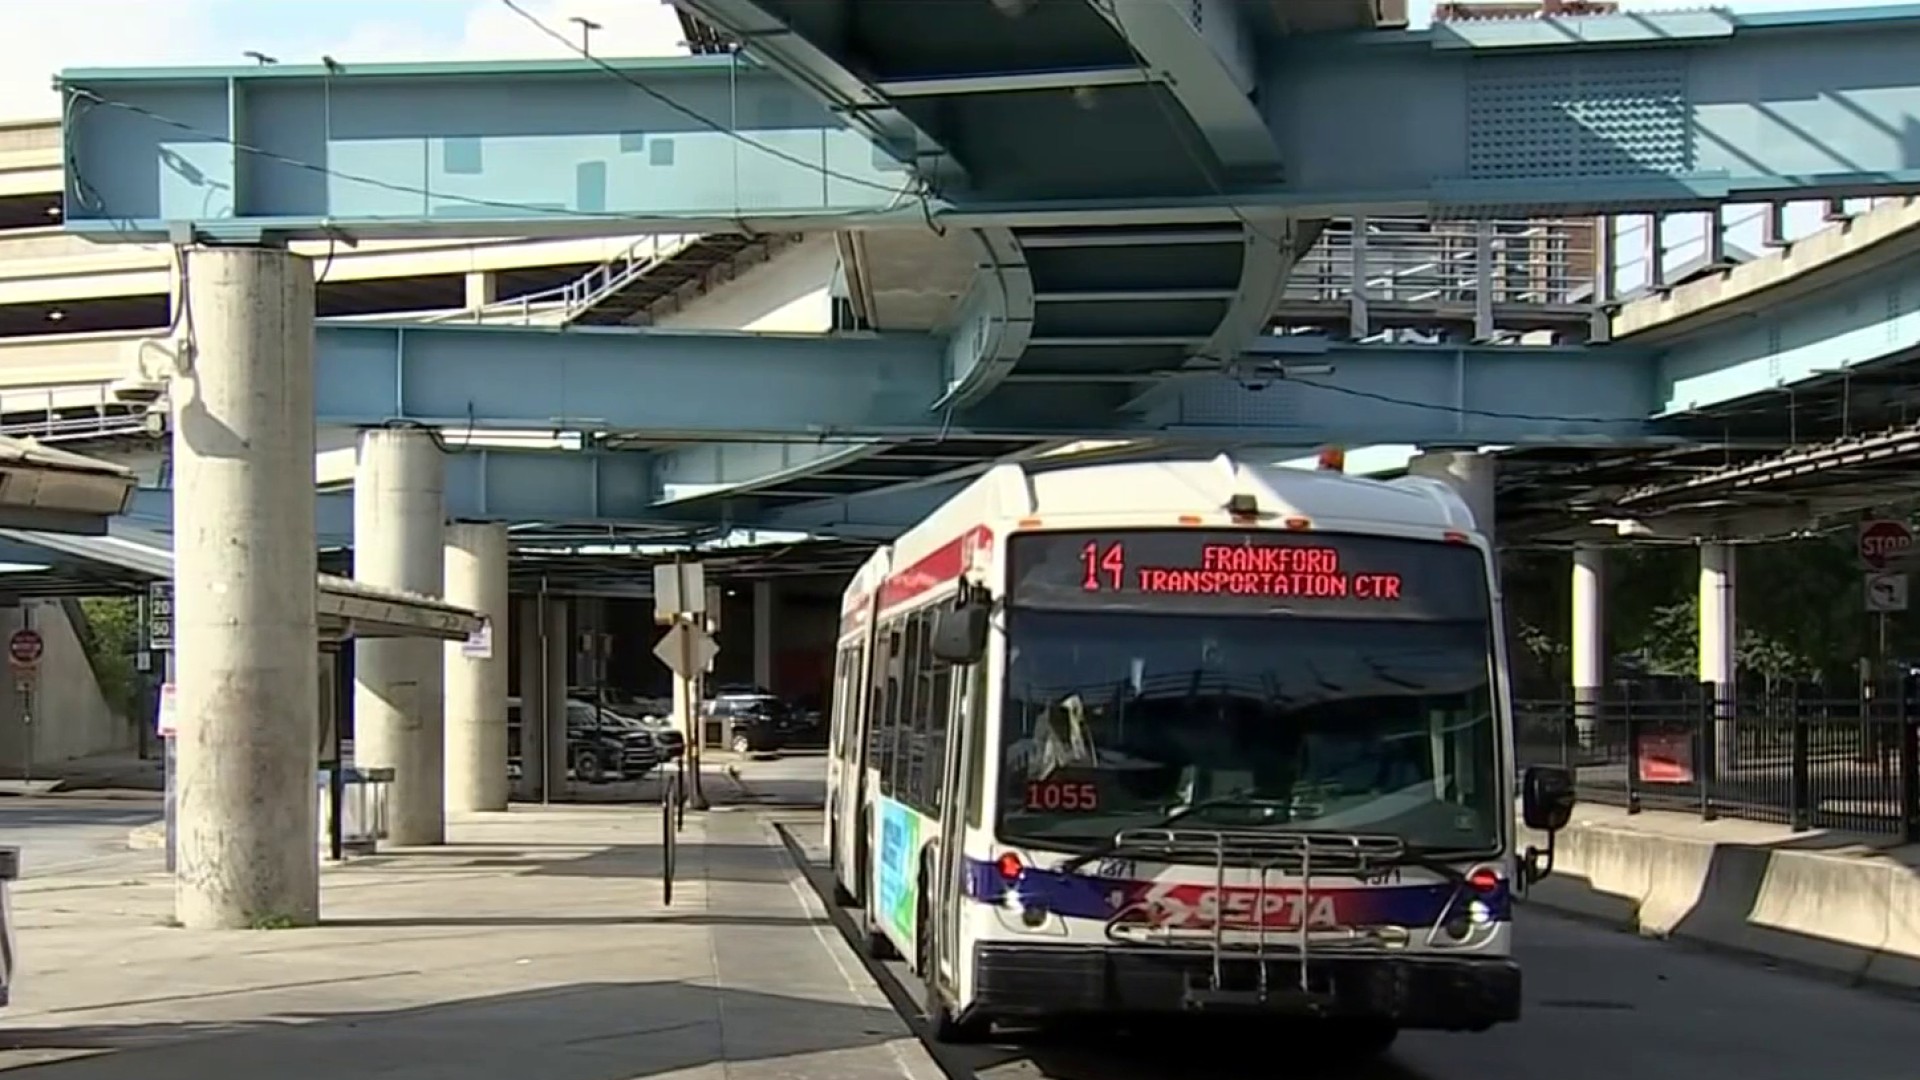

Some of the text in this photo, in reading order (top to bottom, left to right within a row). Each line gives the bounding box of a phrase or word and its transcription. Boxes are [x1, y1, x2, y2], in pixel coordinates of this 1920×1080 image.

[1863, 535, 1910, 555] STOP
[1081, 543, 1123, 590] 14
[1204, 547, 1337, 573] FRANKFORD
[1140, 569, 1400, 598] TRANSPORTATION CTR
[1026, 783, 1097, 810] 1055
[1197, 889, 1336, 927] SEPTA
